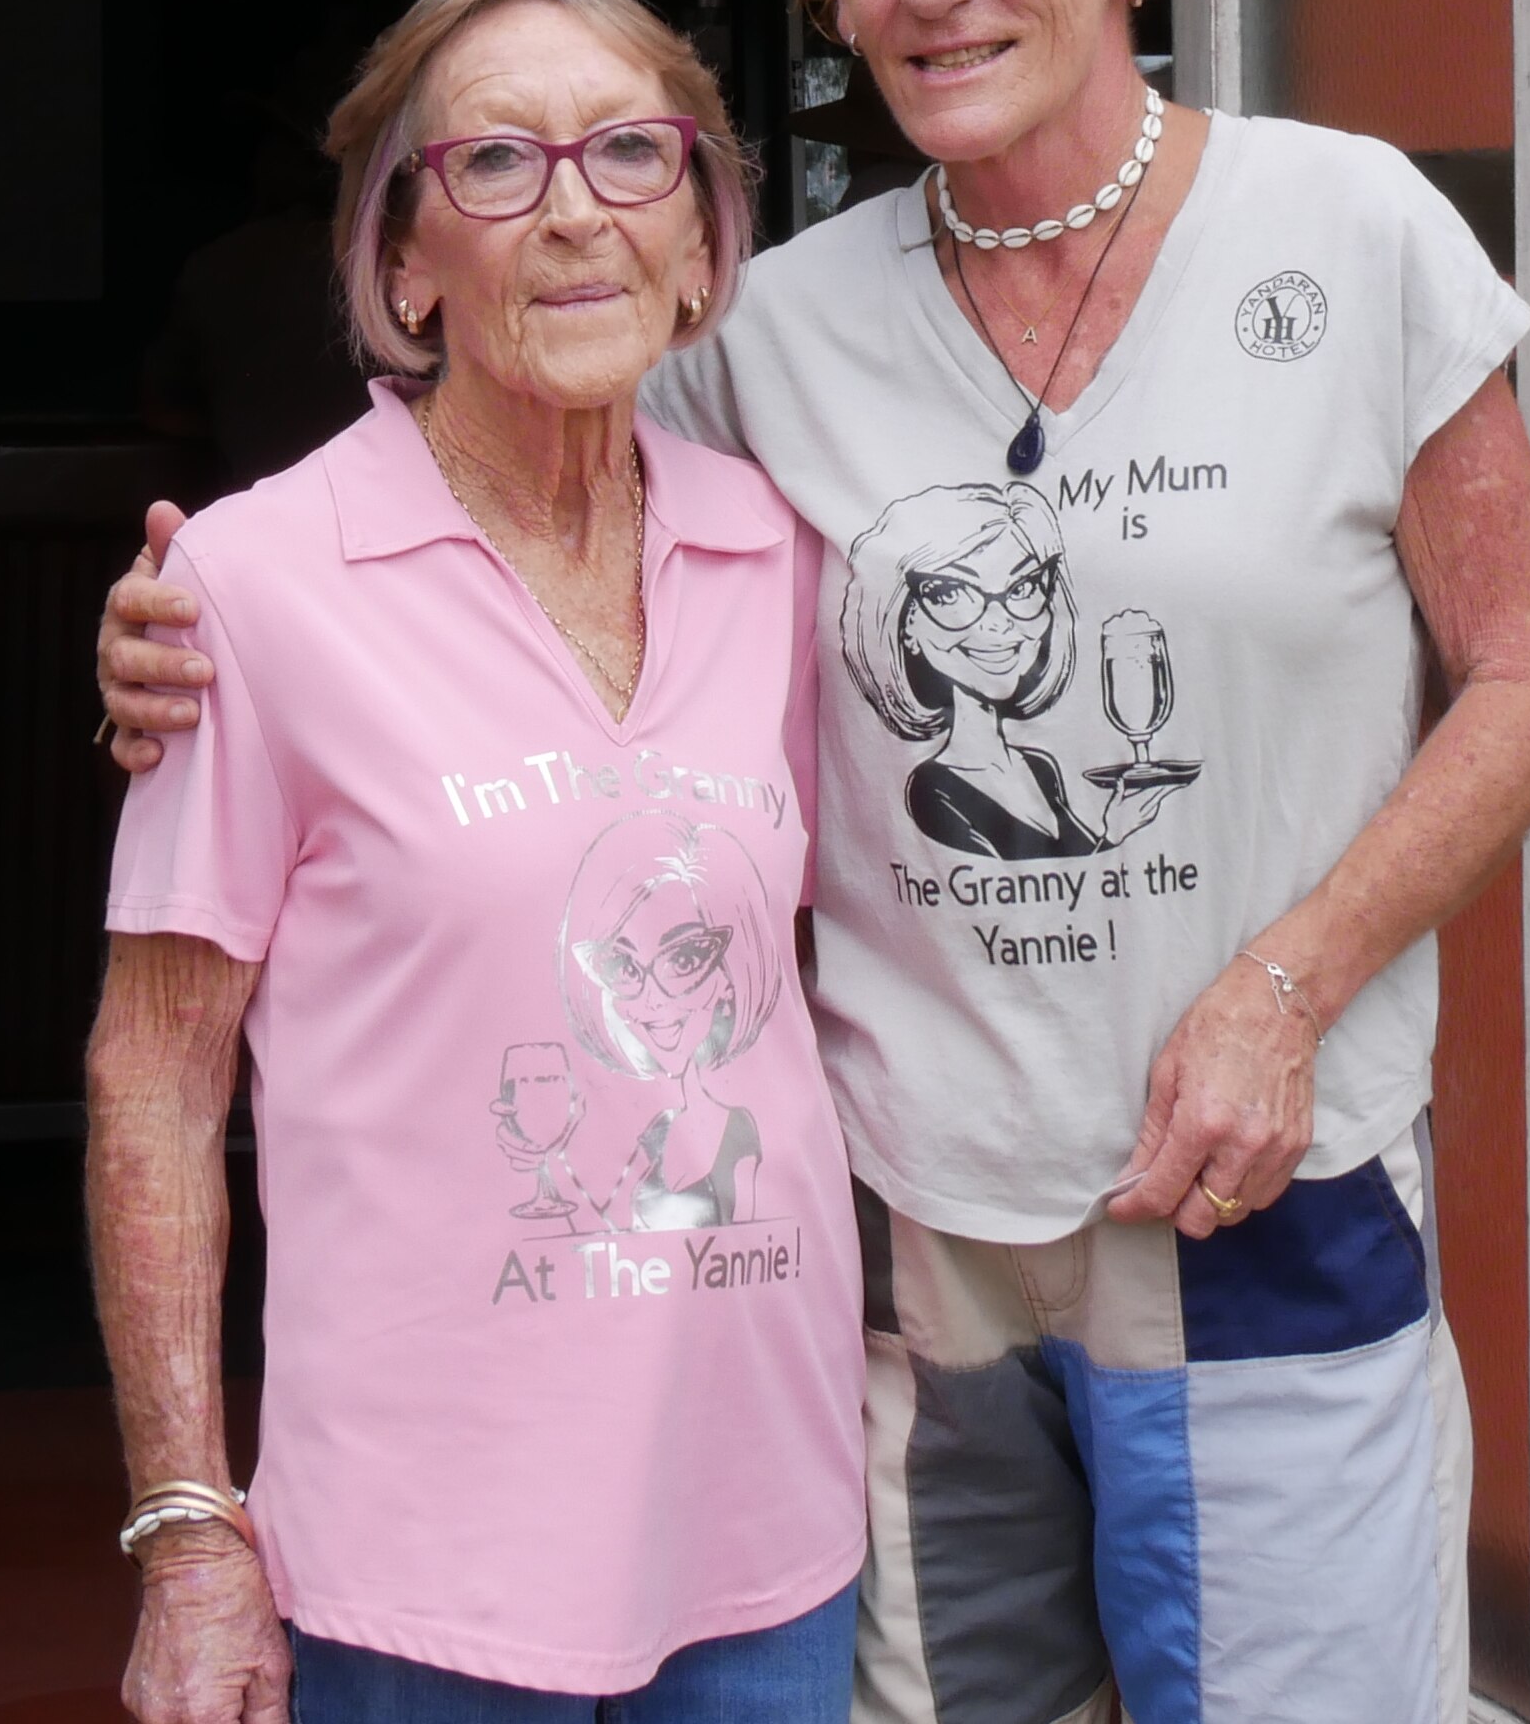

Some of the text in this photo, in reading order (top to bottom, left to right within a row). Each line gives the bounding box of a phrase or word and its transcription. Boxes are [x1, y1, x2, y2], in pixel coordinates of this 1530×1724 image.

[1241, 276, 1324, 317] YANDARAN
[1249, 340, 1315, 358] HOTEL
[1059, 455, 1227, 511] My Mum
[1122, 508, 1148, 539] is
[440, 749, 787, 829] I'm The Granny
[890, 855, 1198, 911] The Granny at the
[492, 1250, 556, 1305] At
[572, 1242, 670, 1299] The
